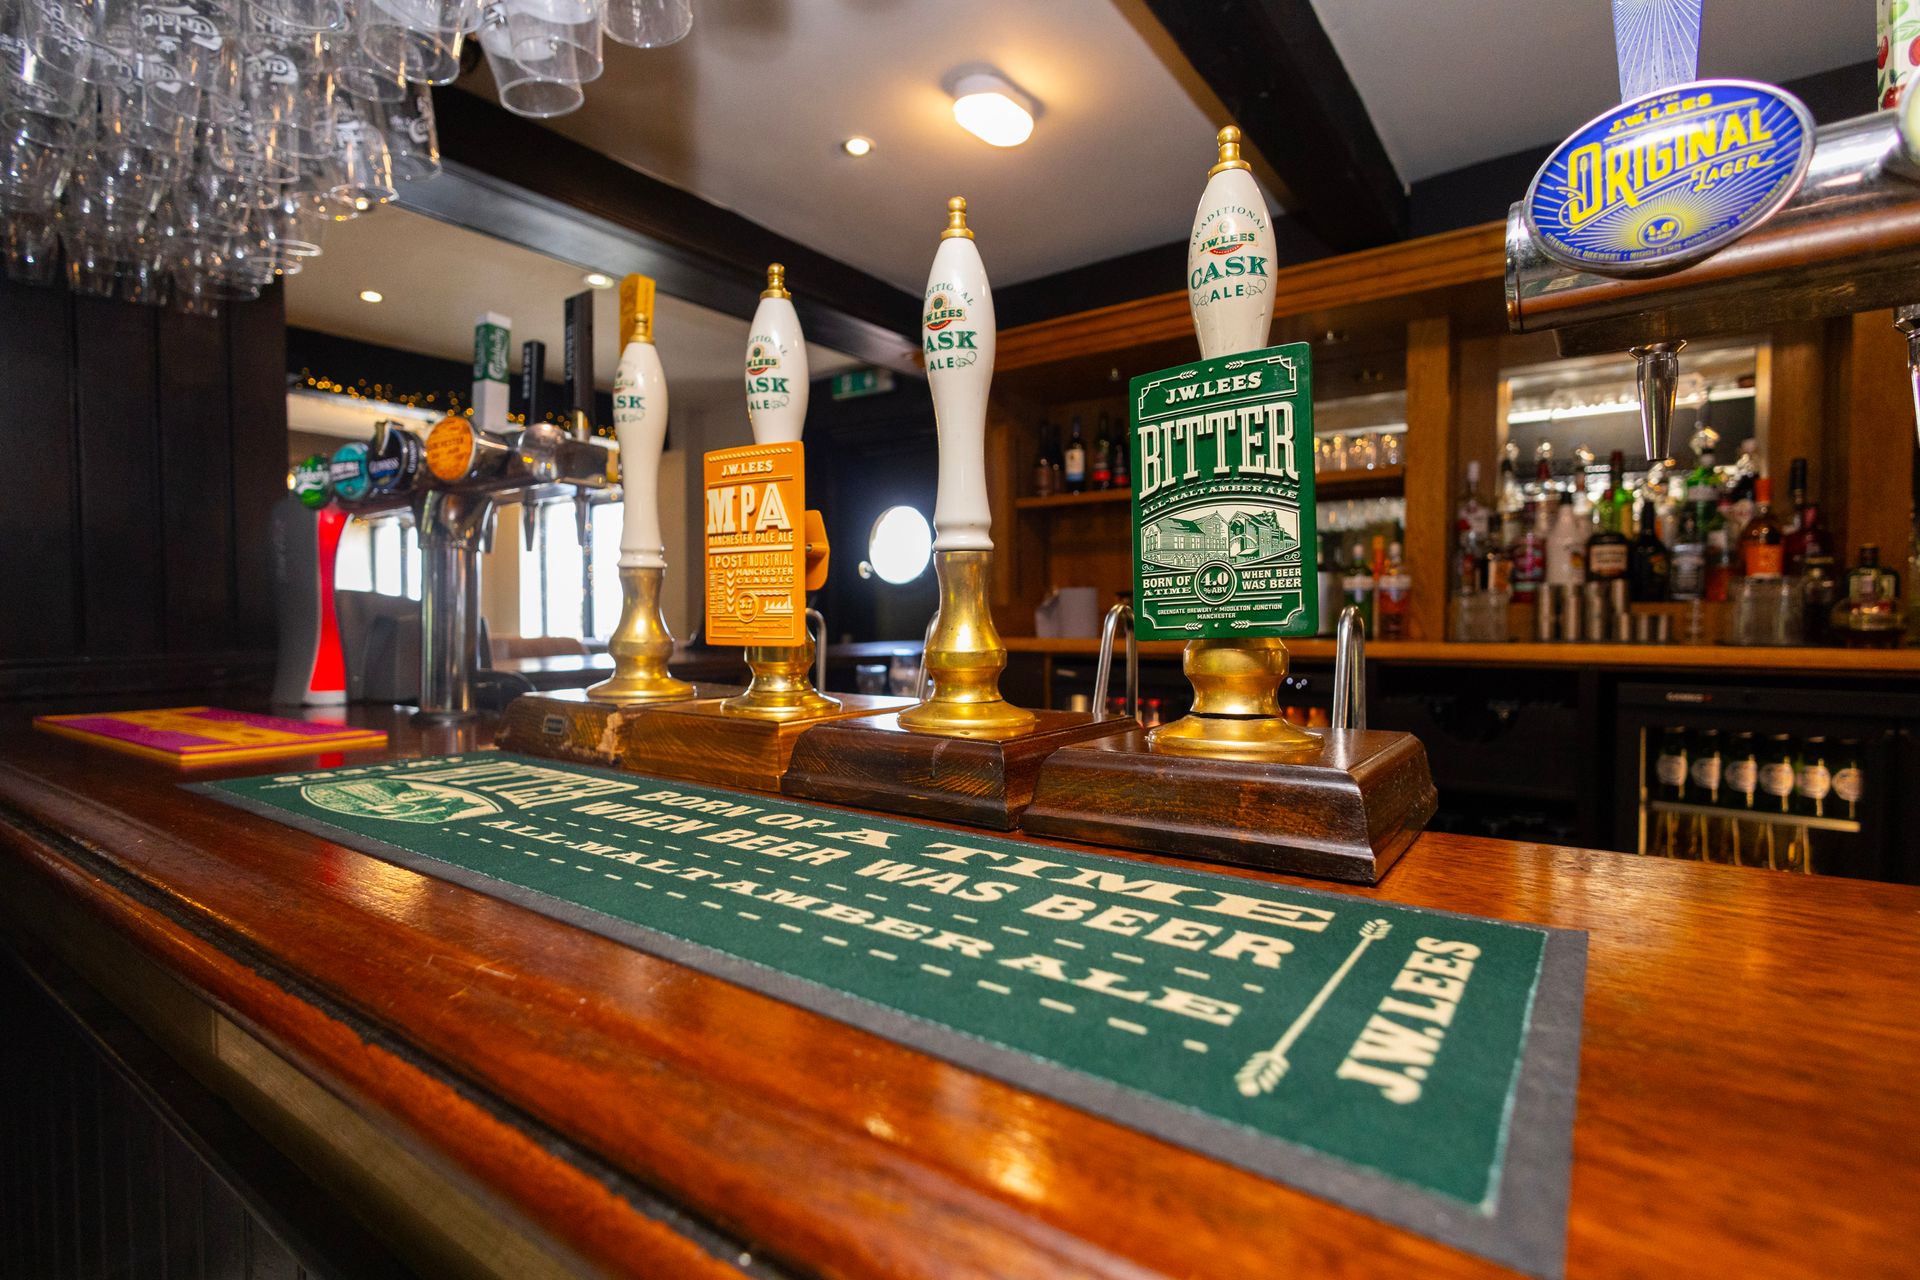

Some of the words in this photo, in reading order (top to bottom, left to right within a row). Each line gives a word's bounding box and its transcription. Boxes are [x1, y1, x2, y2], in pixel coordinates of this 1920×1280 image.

[1558, 108, 1772, 229] ORIGINAL
[1191, 256, 1268, 290] CASK
[1210, 284, 1244, 302] ALE
[925, 331, 978, 354] ASK
[929, 357, 954, 372] ALE
[747, 377, 790, 395] ASK
[1137, 401, 1299, 500] BITTER
[707, 483, 791, 533] MPA
[1142, 487, 1208, 516] ALL-MALT
[1209, 484, 1263, 494] AMBER
[1266, 487, 1298, 499] ALE
[708, 533, 753, 545] MANCHESTER
[755, 532, 775, 544] PALE
[778, 531, 794, 542] ALE
[736, 567, 793, 576] MANCHESTER
[1143, 577, 1172, 588] BORN
[1176, 575, 1191, 586] OF
[1200, 572, 1229, 586] 4.0
[1242, 570, 1271, 579] WHEN
[1276, 568, 1301, 577] BEER
[1155, 587, 1191, 595] TIME
[1242, 579, 1266, 590] WAS
[1270, 577, 1301, 588] BEER
[386, 761, 640, 809] BITTER
[632, 790, 764, 818] BORN
[755, 813, 837, 830] OF
[814, 828, 900, 849] A
[919, 842, 1336, 932] TIME
[571, 801, 719, 834] WHEN
[697, 828, 852, 866] BEER
[854, 859, 1021, 902] WAS
[1021, 893, 1295, 969] BEER
[480, 819, 724, 881] ALL-MALT
[709, 880, 994, 959] AMBER
[996, 953, 1240, 1027] ALE
